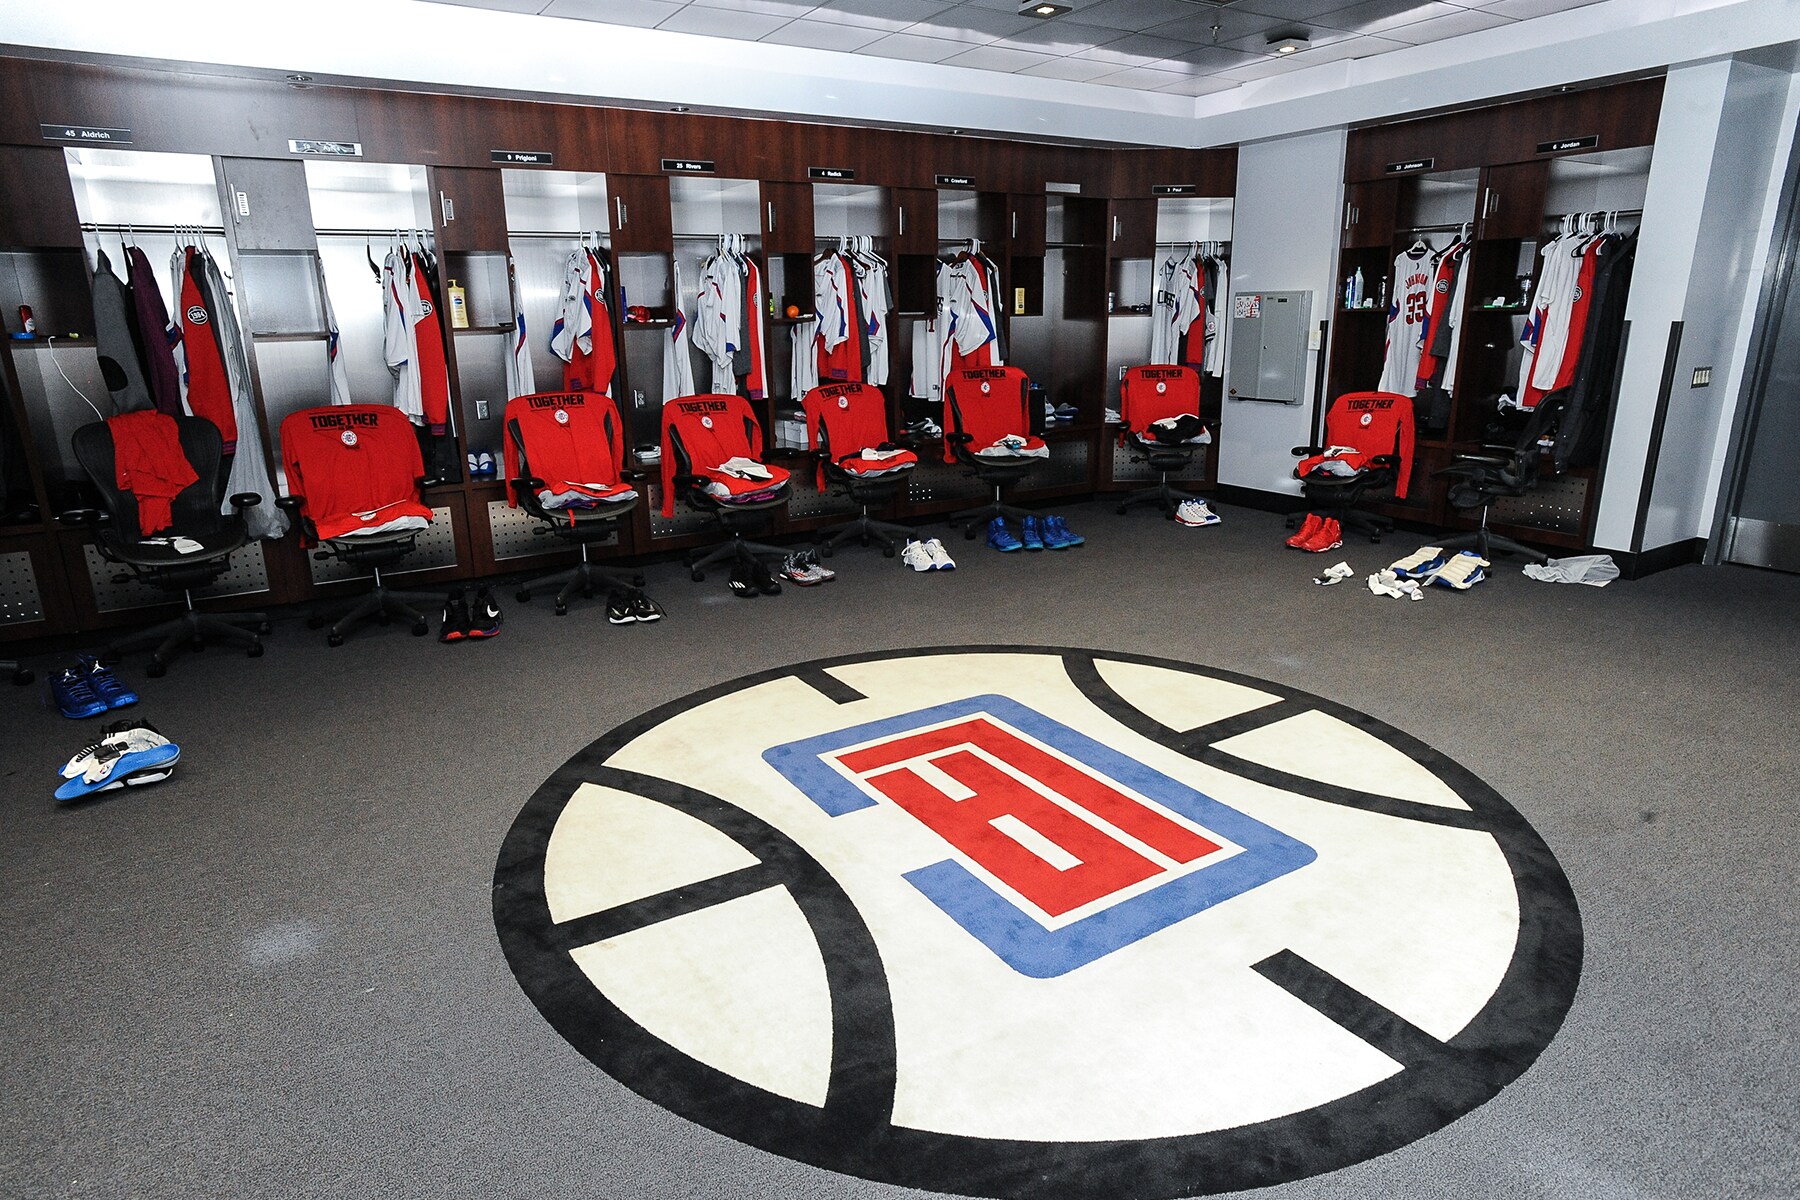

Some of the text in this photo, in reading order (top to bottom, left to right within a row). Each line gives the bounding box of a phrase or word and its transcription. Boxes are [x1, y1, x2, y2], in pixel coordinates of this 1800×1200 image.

[64, 129, 111, 139] 45 Aldrich
[1560, 141, 1580, 149] Jordan
[515, 154, 538, 162] Prigioni
[1403, 162, 1423, 170] Johnson
[1405, 273, 1428, 290] JOHNSON
[1405, 291, 1426, 325] 33
[961, 369, 1006, 379] TOGETHER
[1140, 369, 1183, 378] TOGETHER
[819, 384, 863, 398] TOGETHER
[526, 394, 585, 409] TOGETHER
[677, 401, 728, 413] TOGETHER
[1347, 399, 1395, 411] TOGETHER
[309, 413, 379, 429] TOGETHER
